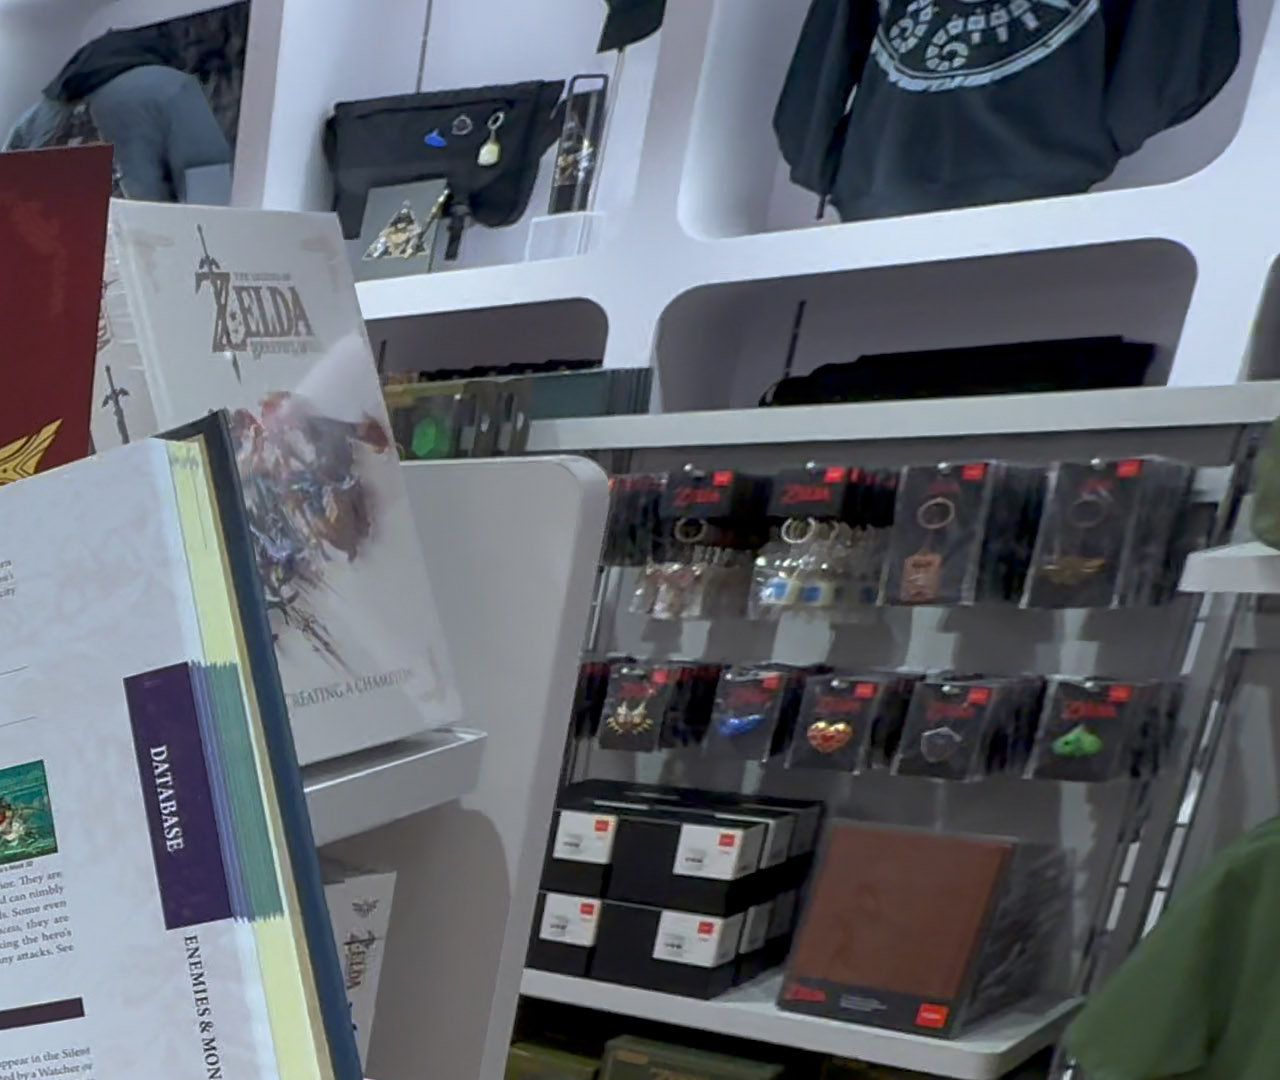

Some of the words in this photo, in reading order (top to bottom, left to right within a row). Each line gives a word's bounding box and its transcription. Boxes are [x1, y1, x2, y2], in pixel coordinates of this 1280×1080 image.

[195, 272, 315, 352] ZELDA
[151, 746, 184, 853] DATABASE
[185, 935, 209, 1019] ENEMIES
[200, 1020, 212, 1033] &
